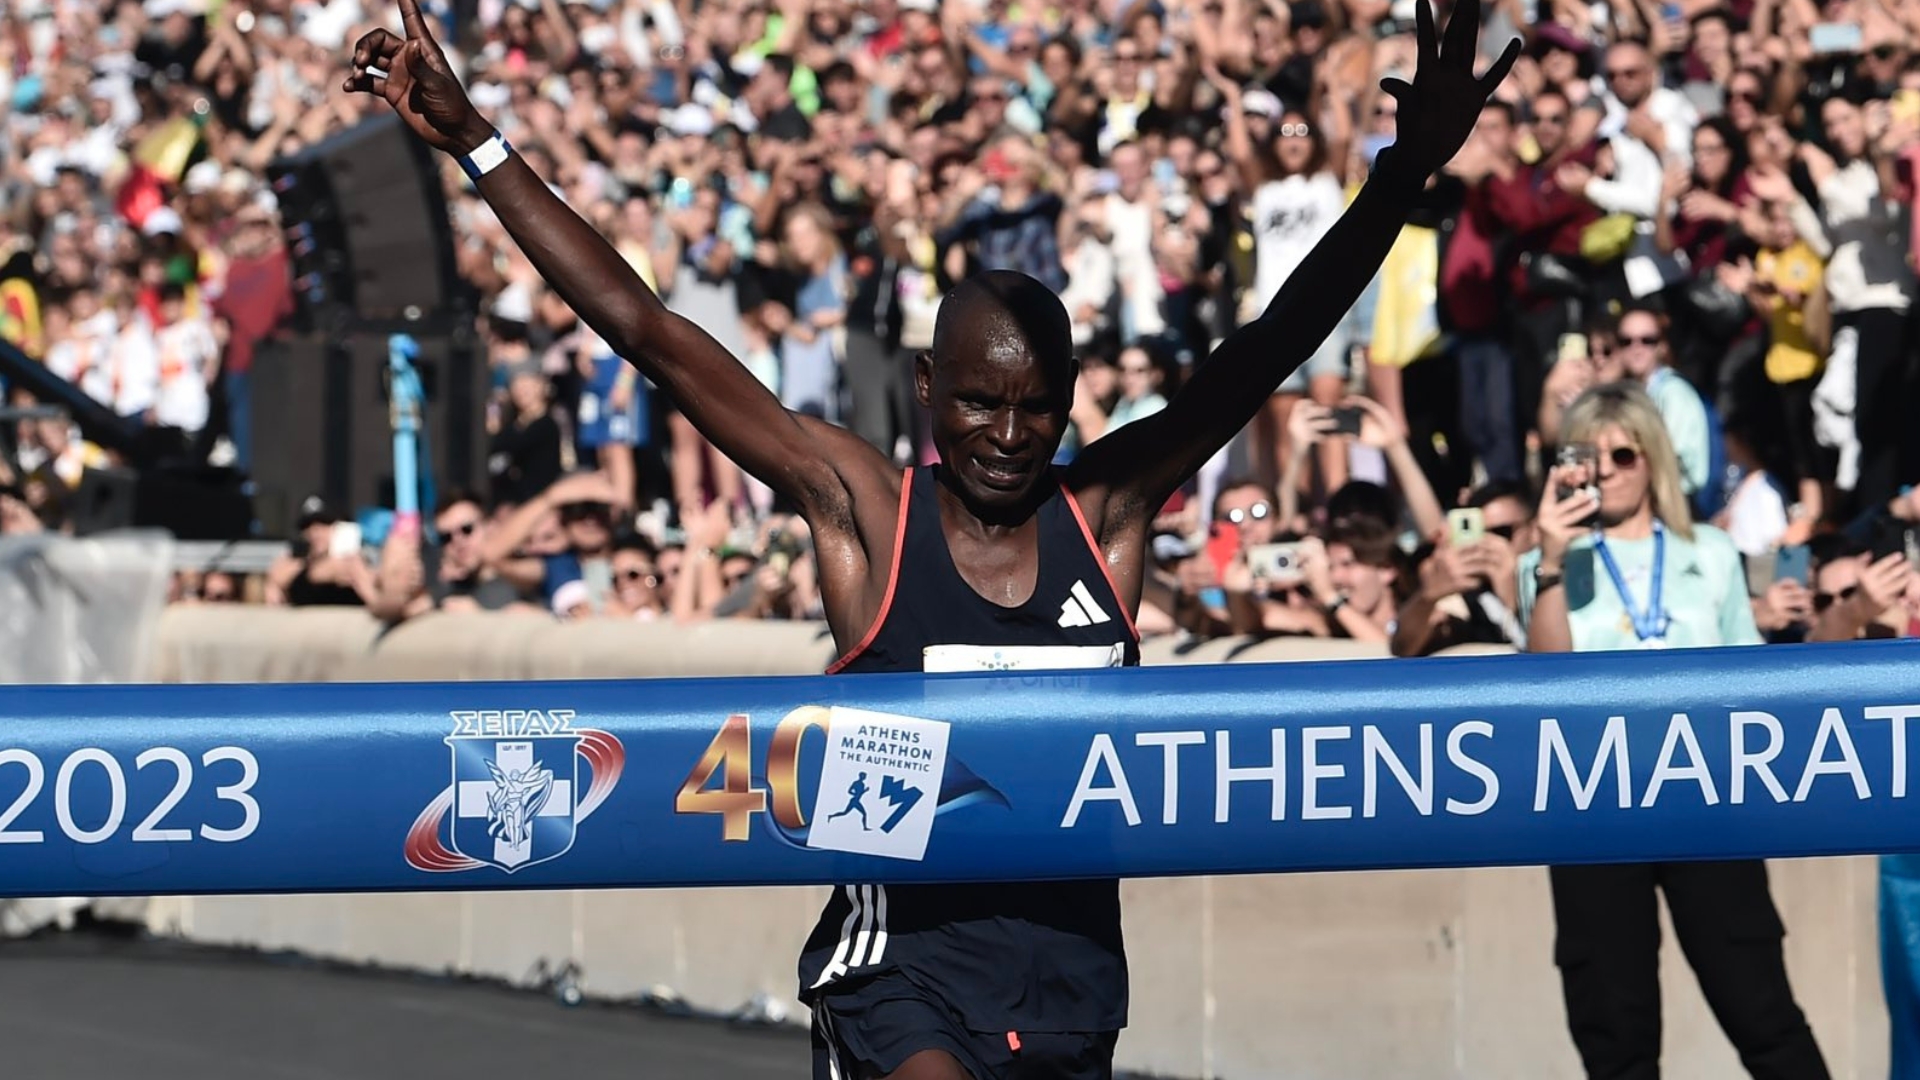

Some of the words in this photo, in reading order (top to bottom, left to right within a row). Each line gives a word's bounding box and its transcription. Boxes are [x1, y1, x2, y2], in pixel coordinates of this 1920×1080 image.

[449, 710, 576, 737] ΣΕΓΑΣ
[858, 725, 920, 743] ATHENS
[841, 737, 932, 760] MARATHON
[840, 751, 862, 762] THE
[866, 755, 930, 772] AUTHENTIC
[1060, 720, 1500, 828] ATHENS
[1533, 704, 1920, 811] MARAT
[0, 747, 260, 844] 2023
